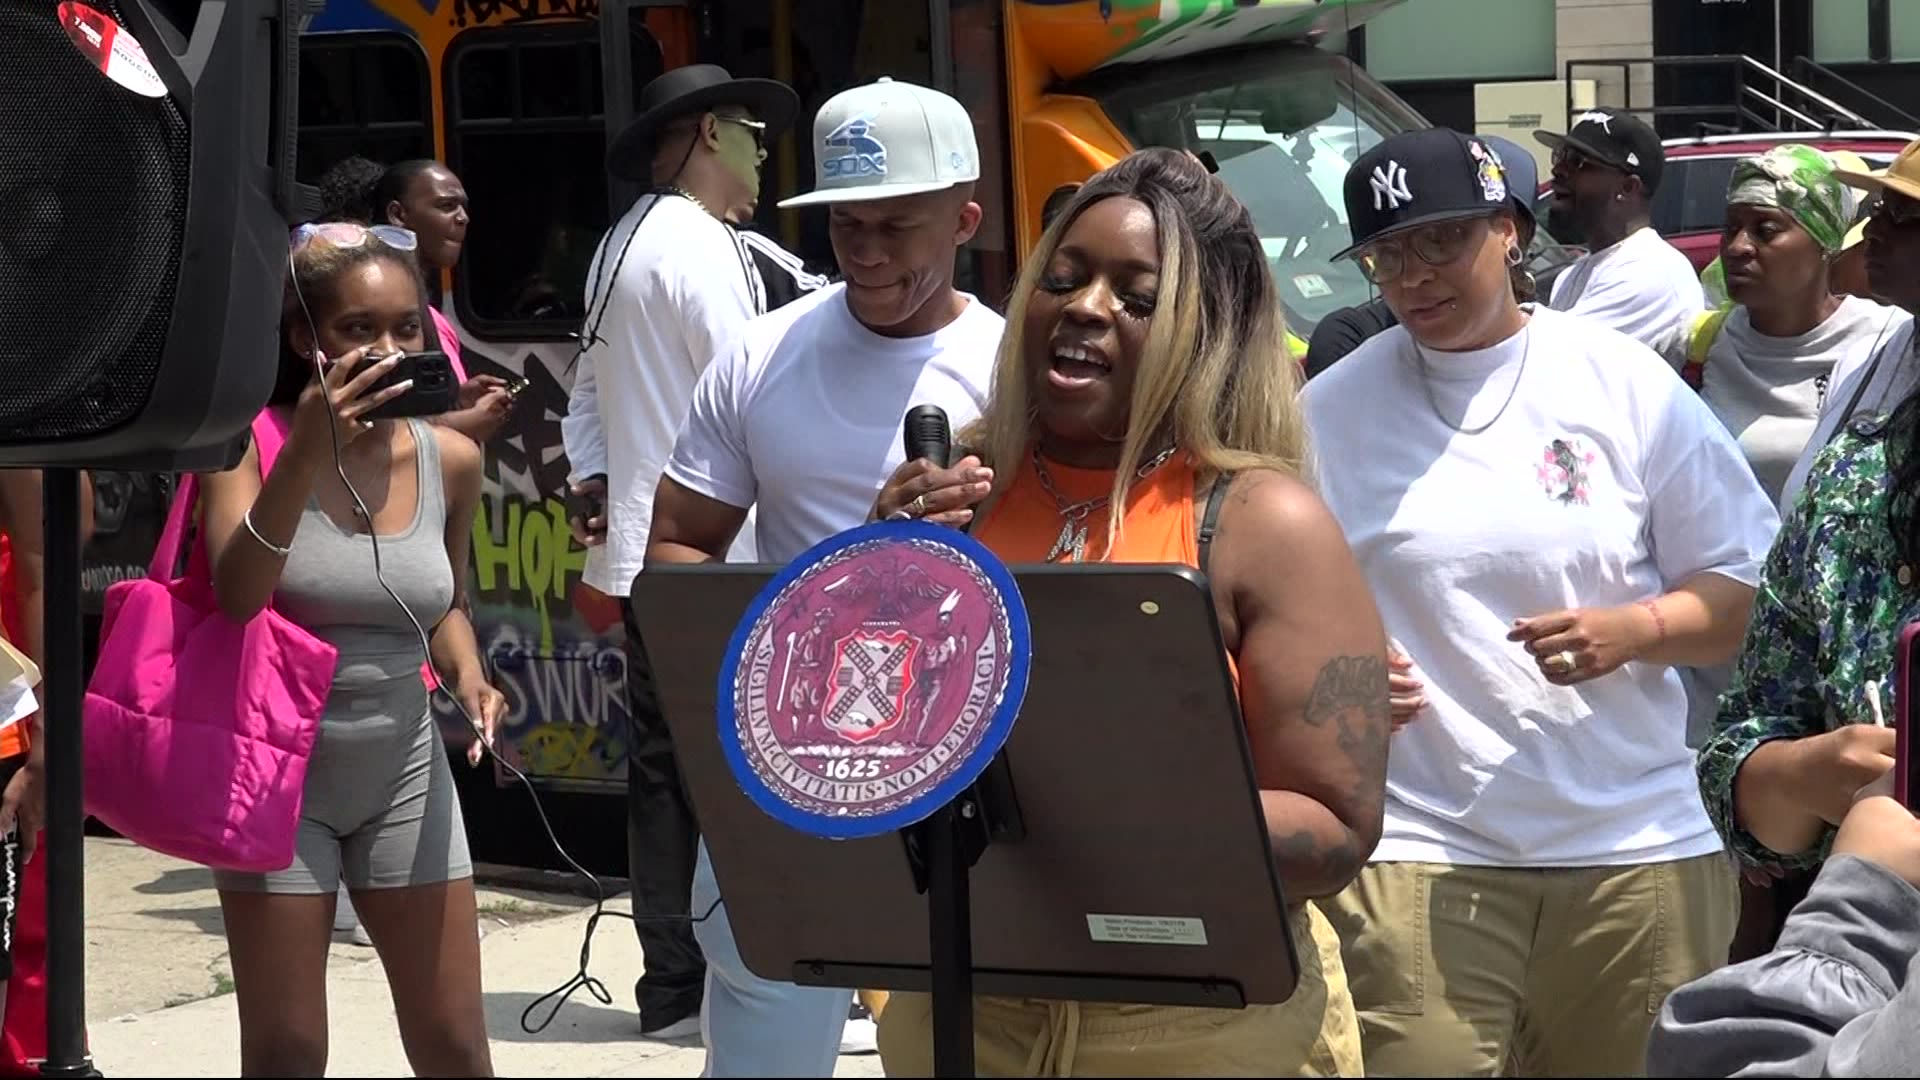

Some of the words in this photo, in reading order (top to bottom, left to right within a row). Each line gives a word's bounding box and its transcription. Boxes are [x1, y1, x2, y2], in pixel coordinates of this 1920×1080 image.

[823, 153, 888, 180] SOX
[1369, 160, 1413, 211] NY
[751, 649, 774, 753] SIGILLVM
[770, 751, 876, 800] CIVITATIS
[882, 754, 940, 797] NOVI
[941, 653, 995, 749] EBORACI
[825, 758, 881, 779] 1625
[0, 840, 19, 952] hampion
